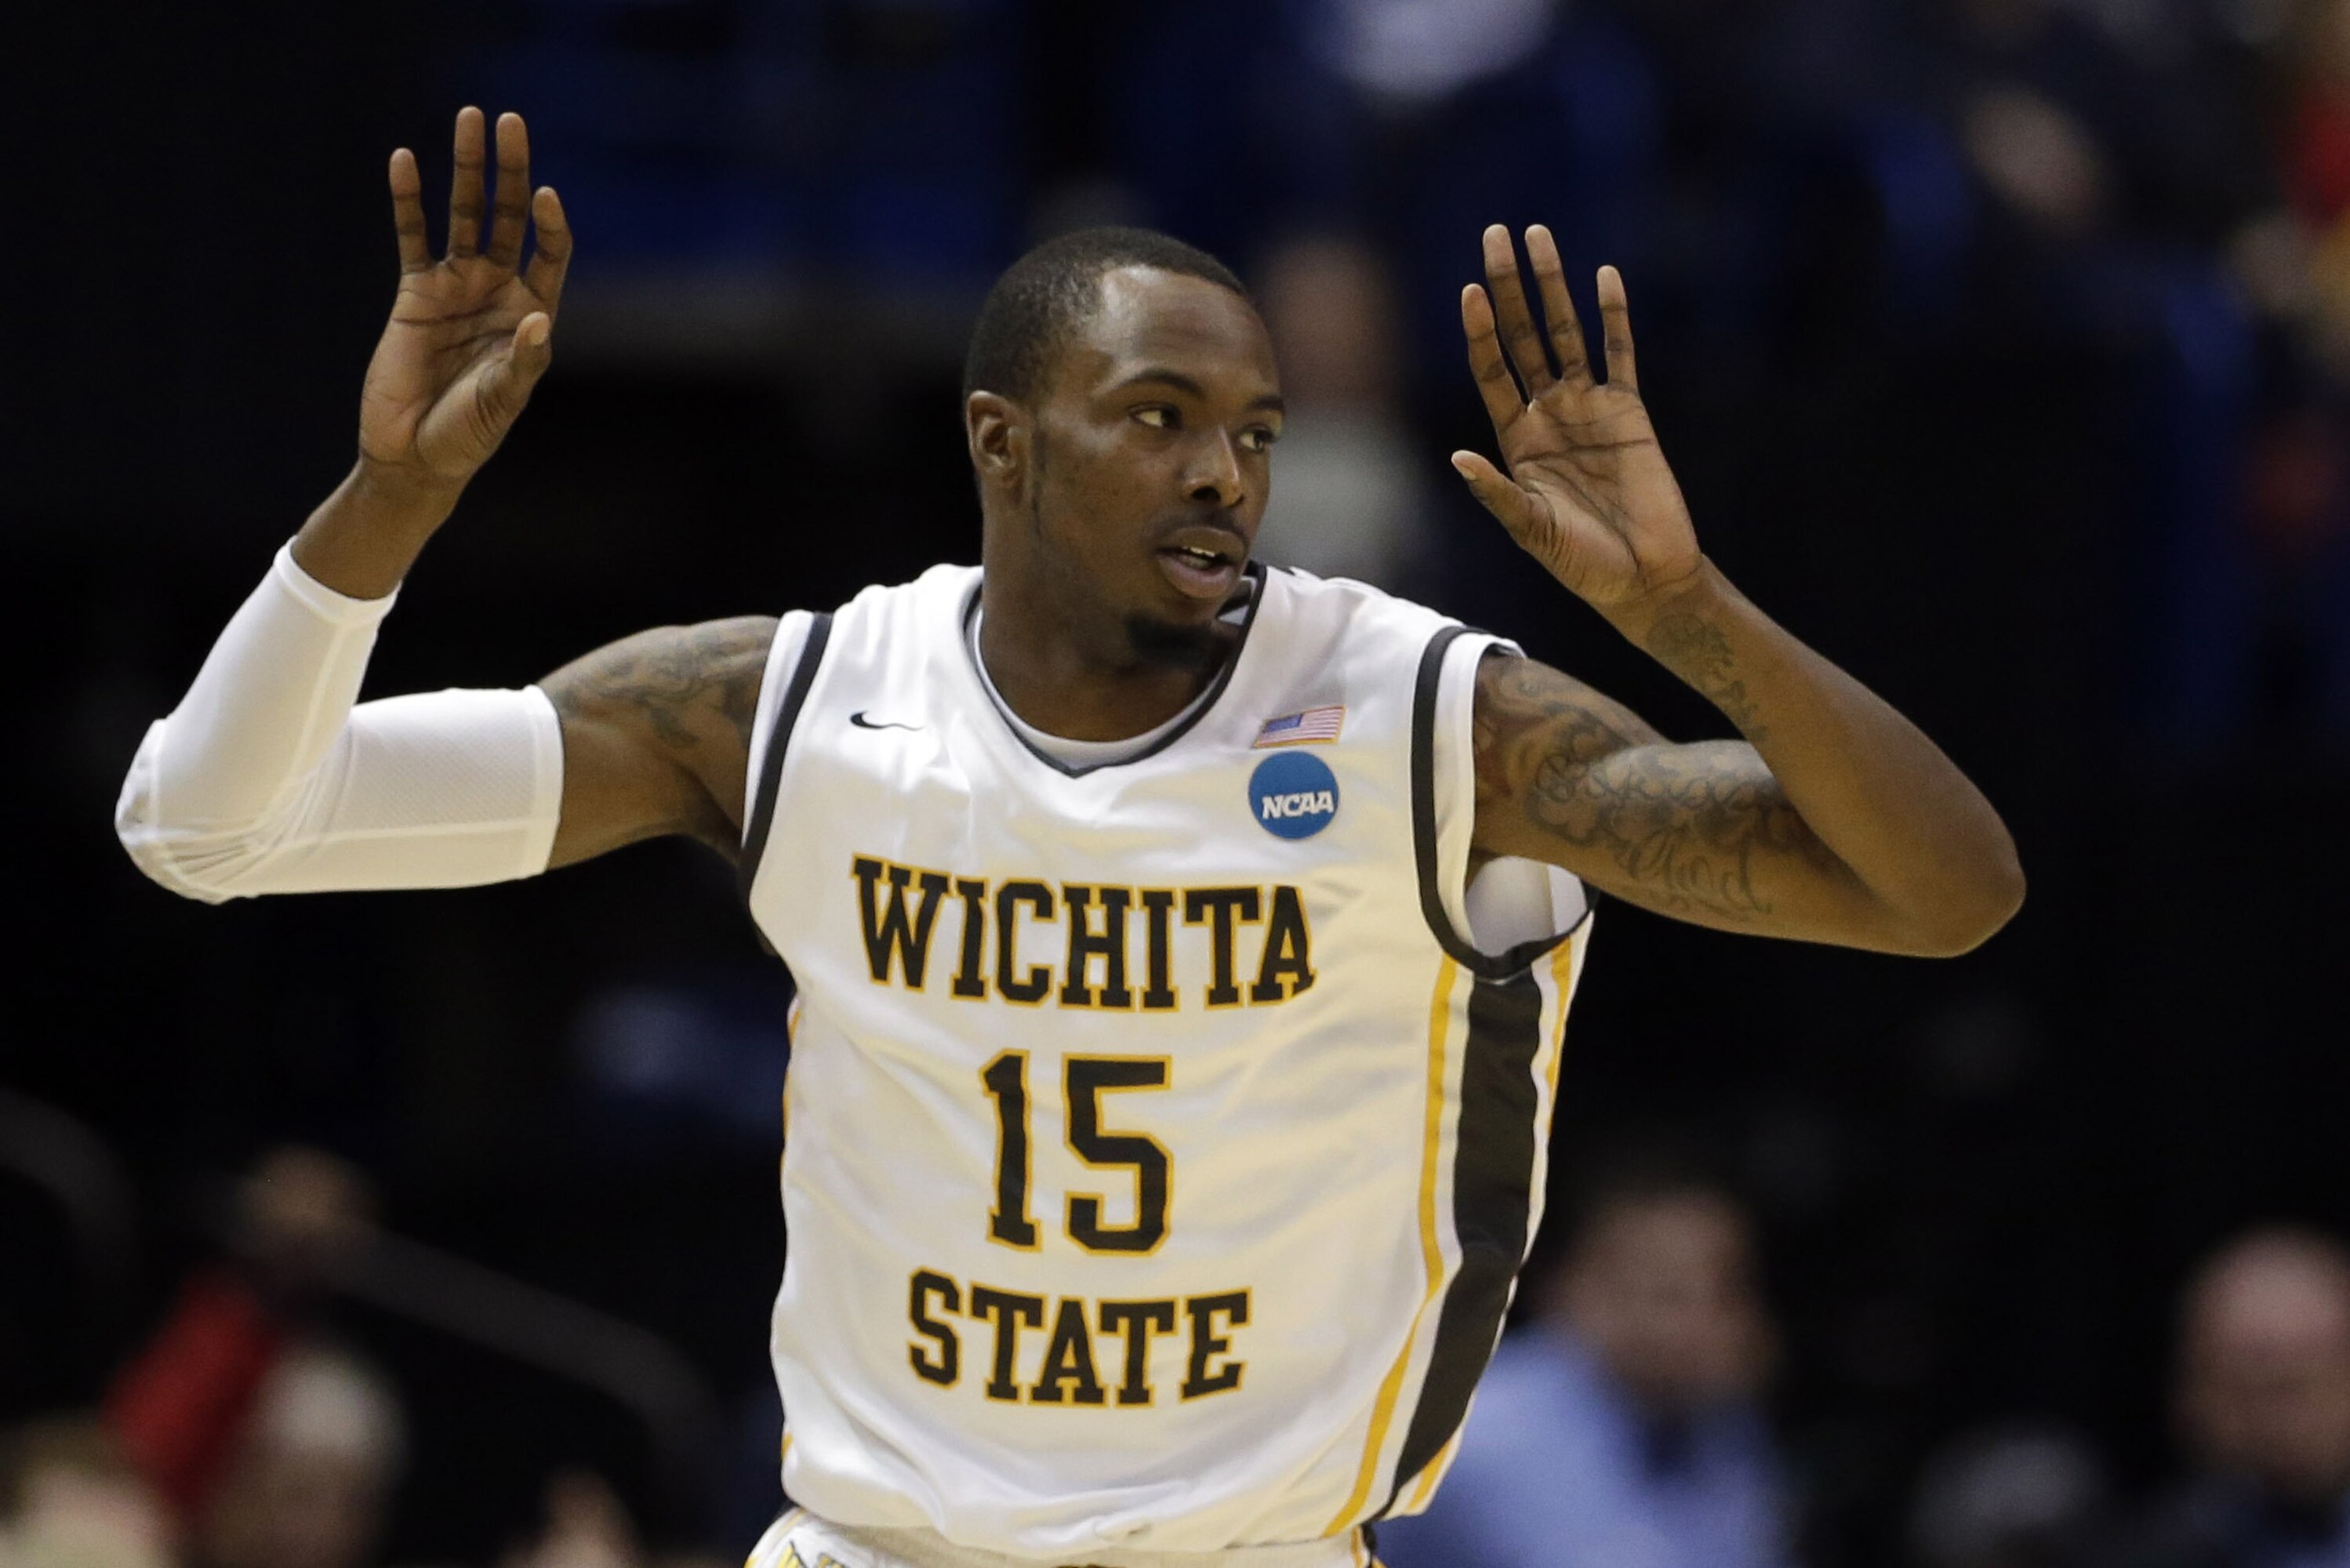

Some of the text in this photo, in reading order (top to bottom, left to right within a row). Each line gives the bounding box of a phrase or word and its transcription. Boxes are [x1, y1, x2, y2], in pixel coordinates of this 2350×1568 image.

[1262, 790, 1334, 819] NCAA
[851, 853, 1317, 1012] WICHITA
[979, 1048, 1174, 1256] 15
[907, 1266, 1252, 1406] STATE
